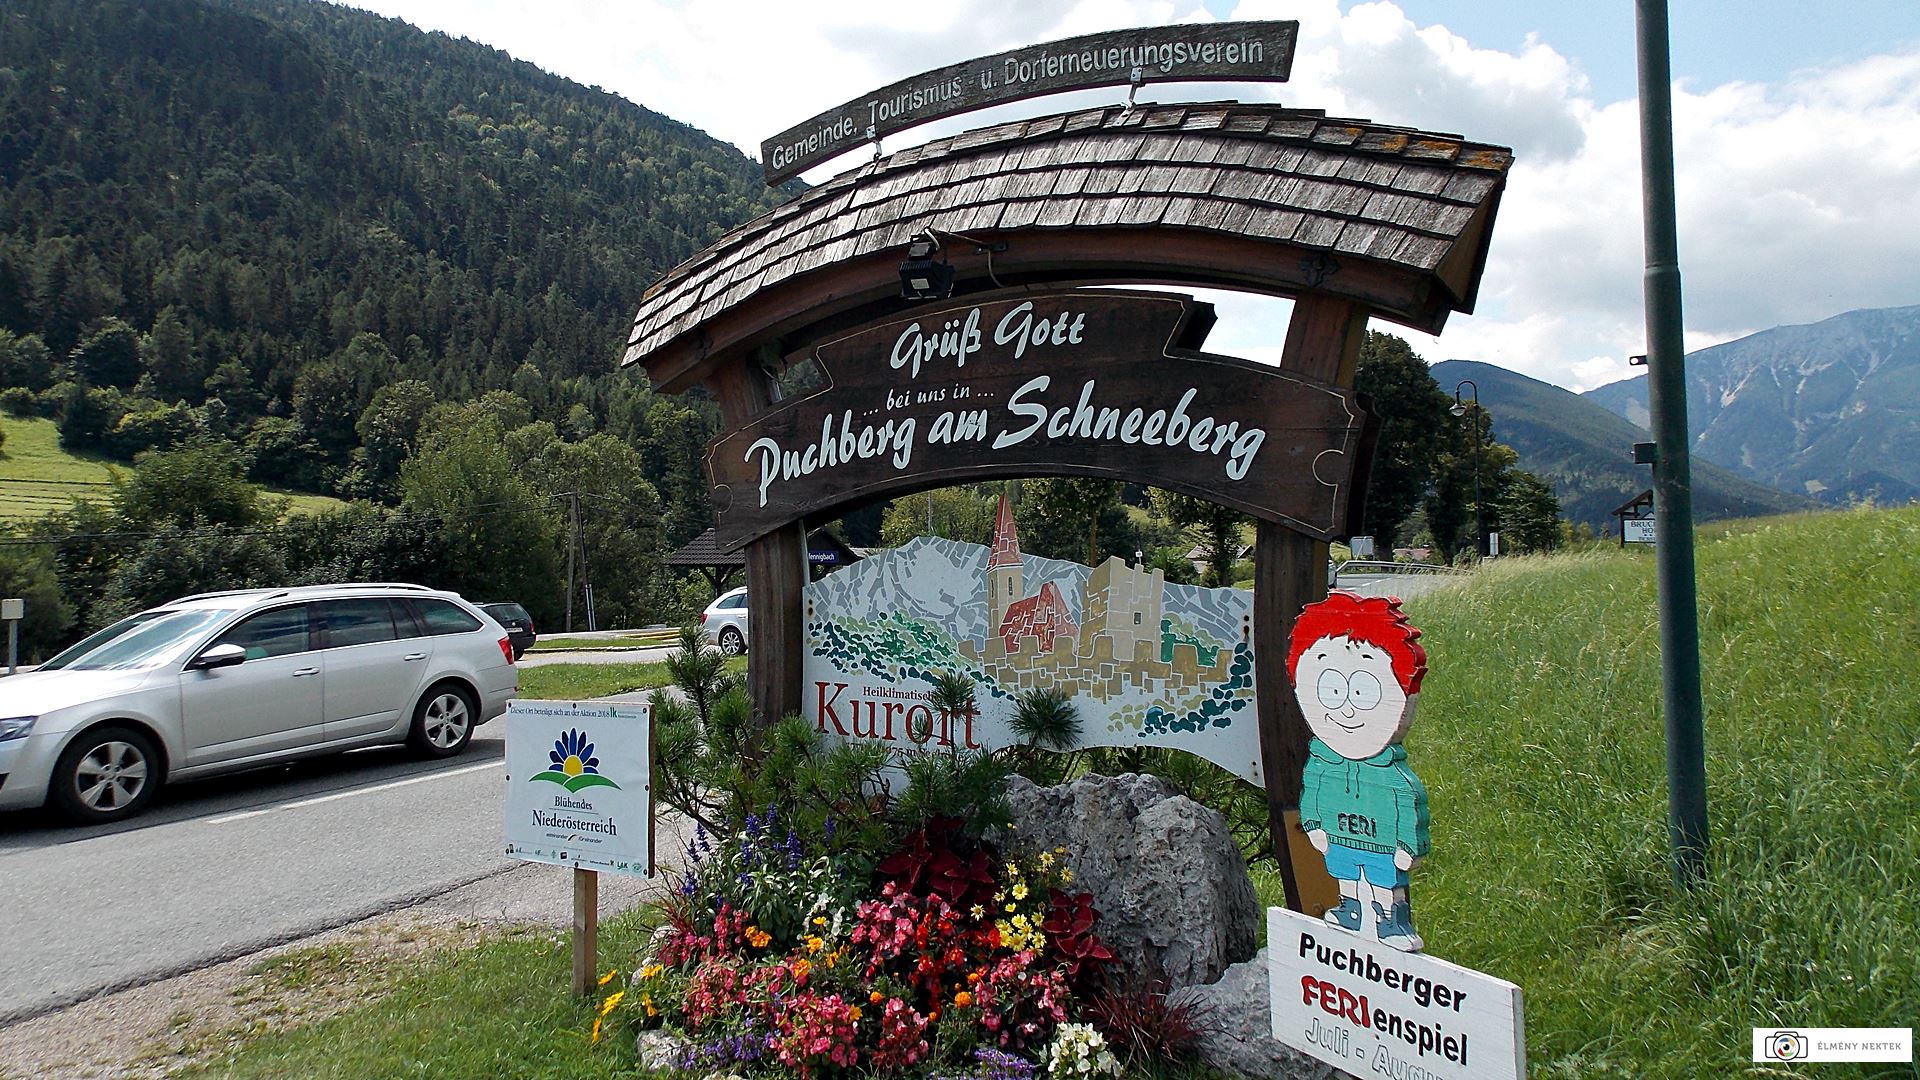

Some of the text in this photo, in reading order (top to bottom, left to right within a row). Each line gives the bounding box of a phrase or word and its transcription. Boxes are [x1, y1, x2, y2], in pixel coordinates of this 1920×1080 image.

[771, 115, 858, 170] Gemeinde,
[867, 74, 962, 131] Tourismus
[981, 69, 998, 90] u.
[1003, 38, 1264, 86] Dorferneuerungsverein
[889, 301, 1085, 379] Grüß Gott
[886, 388, 912, 411] bei
[917, 385, 947, 404] uns
[952, 384, 971, 401] in
[743, 375, 1266, 508] Puchberg am Schneeberg
[813, 681, 981, 750] Kurort
[532, 809, 617, 836] Niederösterreich
[554, 795, 593, 811] Blühendes
[1299, 932, 1468, 1012] Puchberger
[1305, 1016, 1349, 1058] Juli
